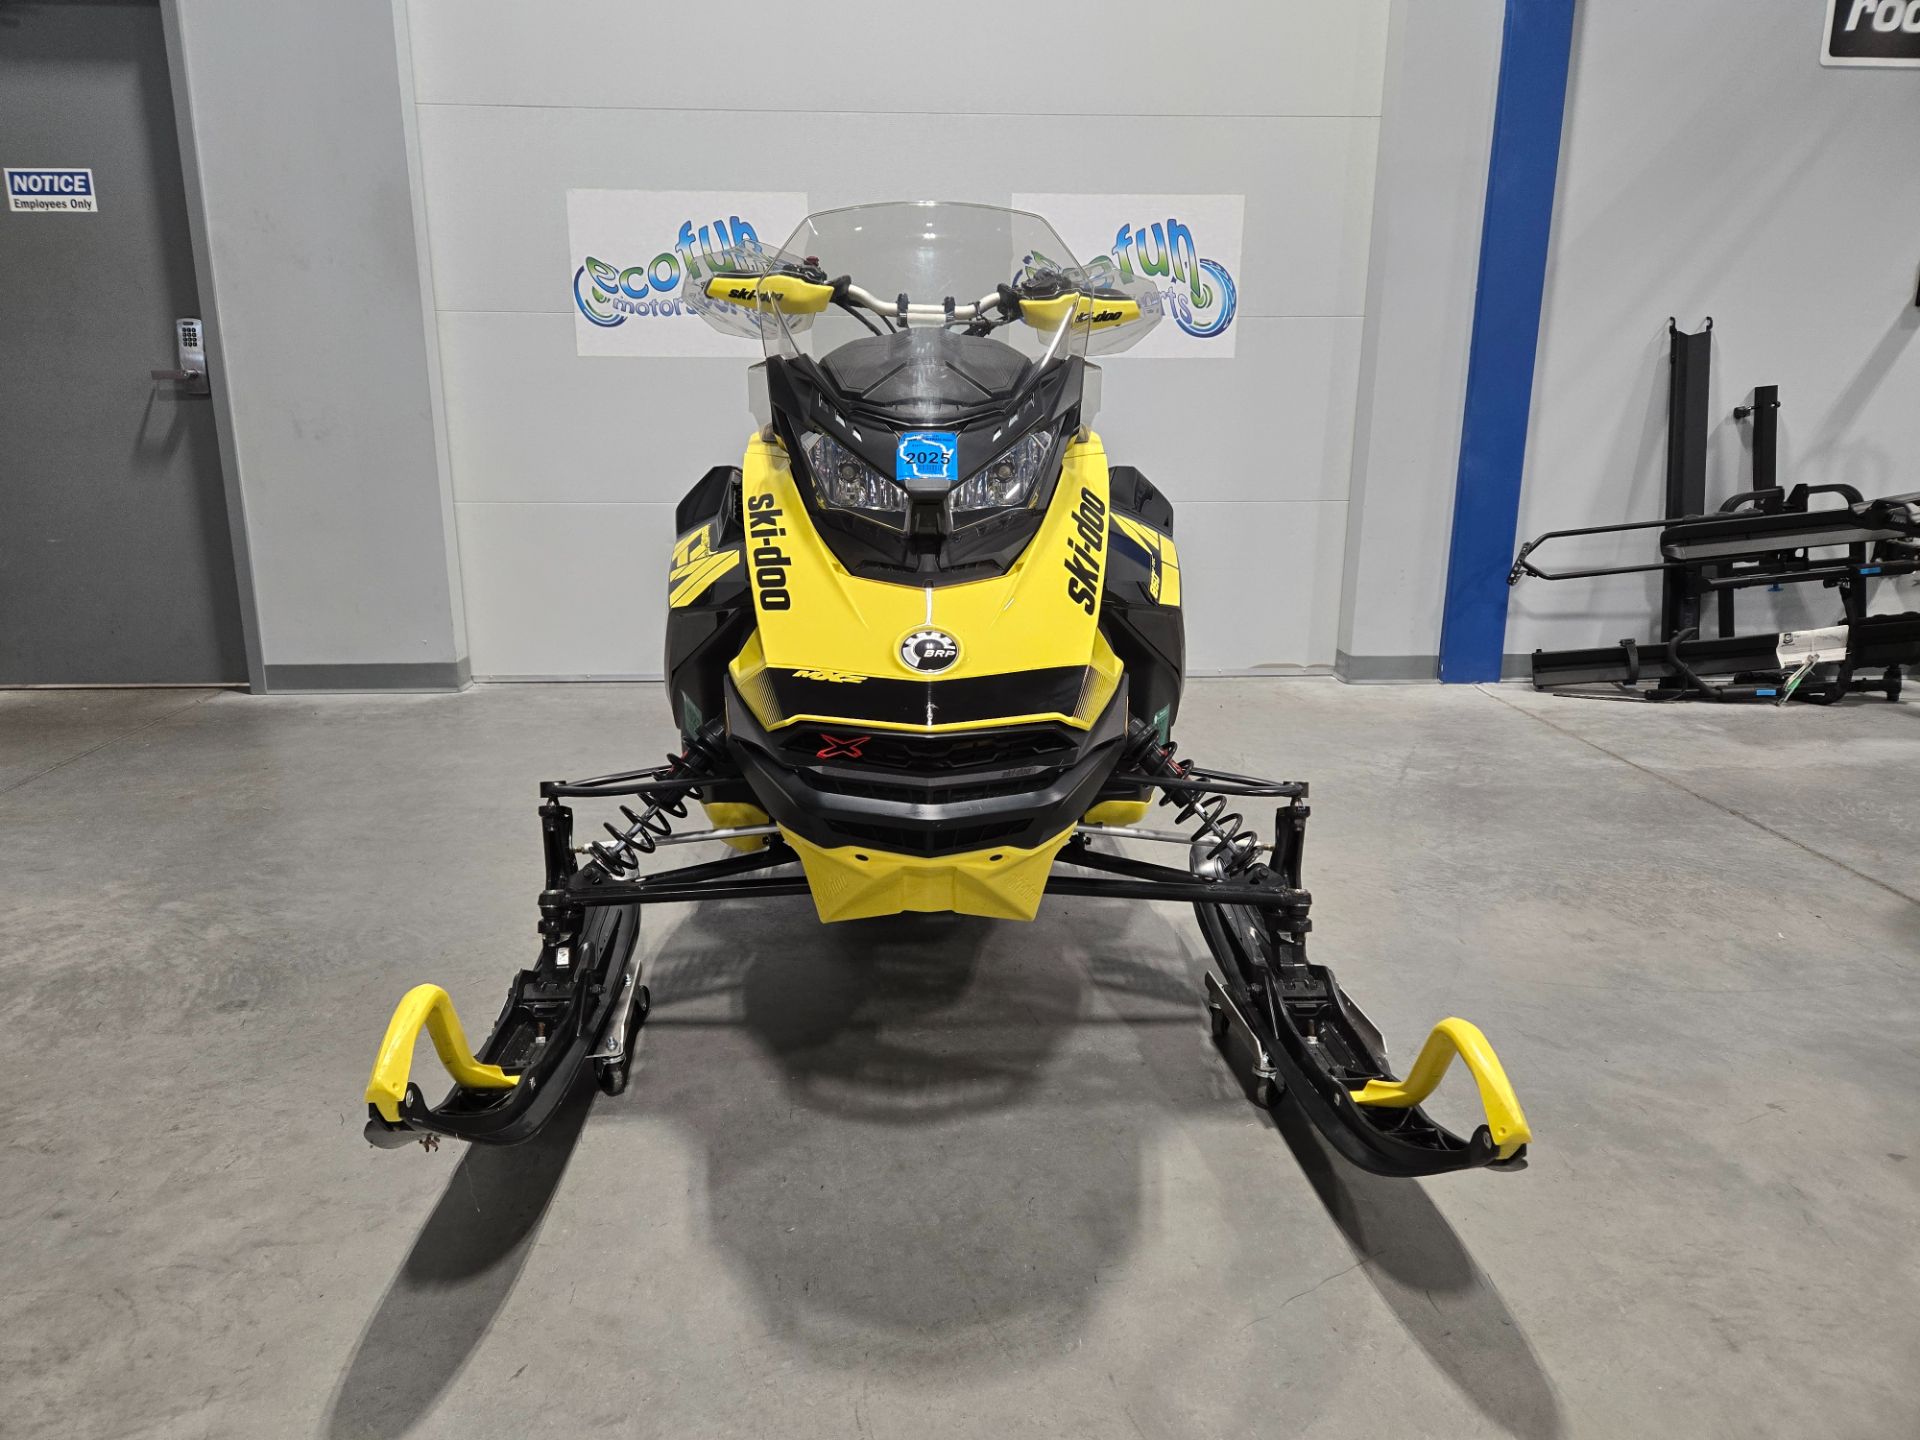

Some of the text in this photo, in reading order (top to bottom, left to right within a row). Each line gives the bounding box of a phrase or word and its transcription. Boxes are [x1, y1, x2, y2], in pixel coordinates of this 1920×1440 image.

[13, 174, 87, 193] NOTICE
[14, 199, 92, 211] Employees Only
[905, 451, 951, 465] 2025
[748, 493, 792, 611] ski-doo
[1064, 486, 1106, 616] ski-doo
[923, 649, 956, 658] BRP
